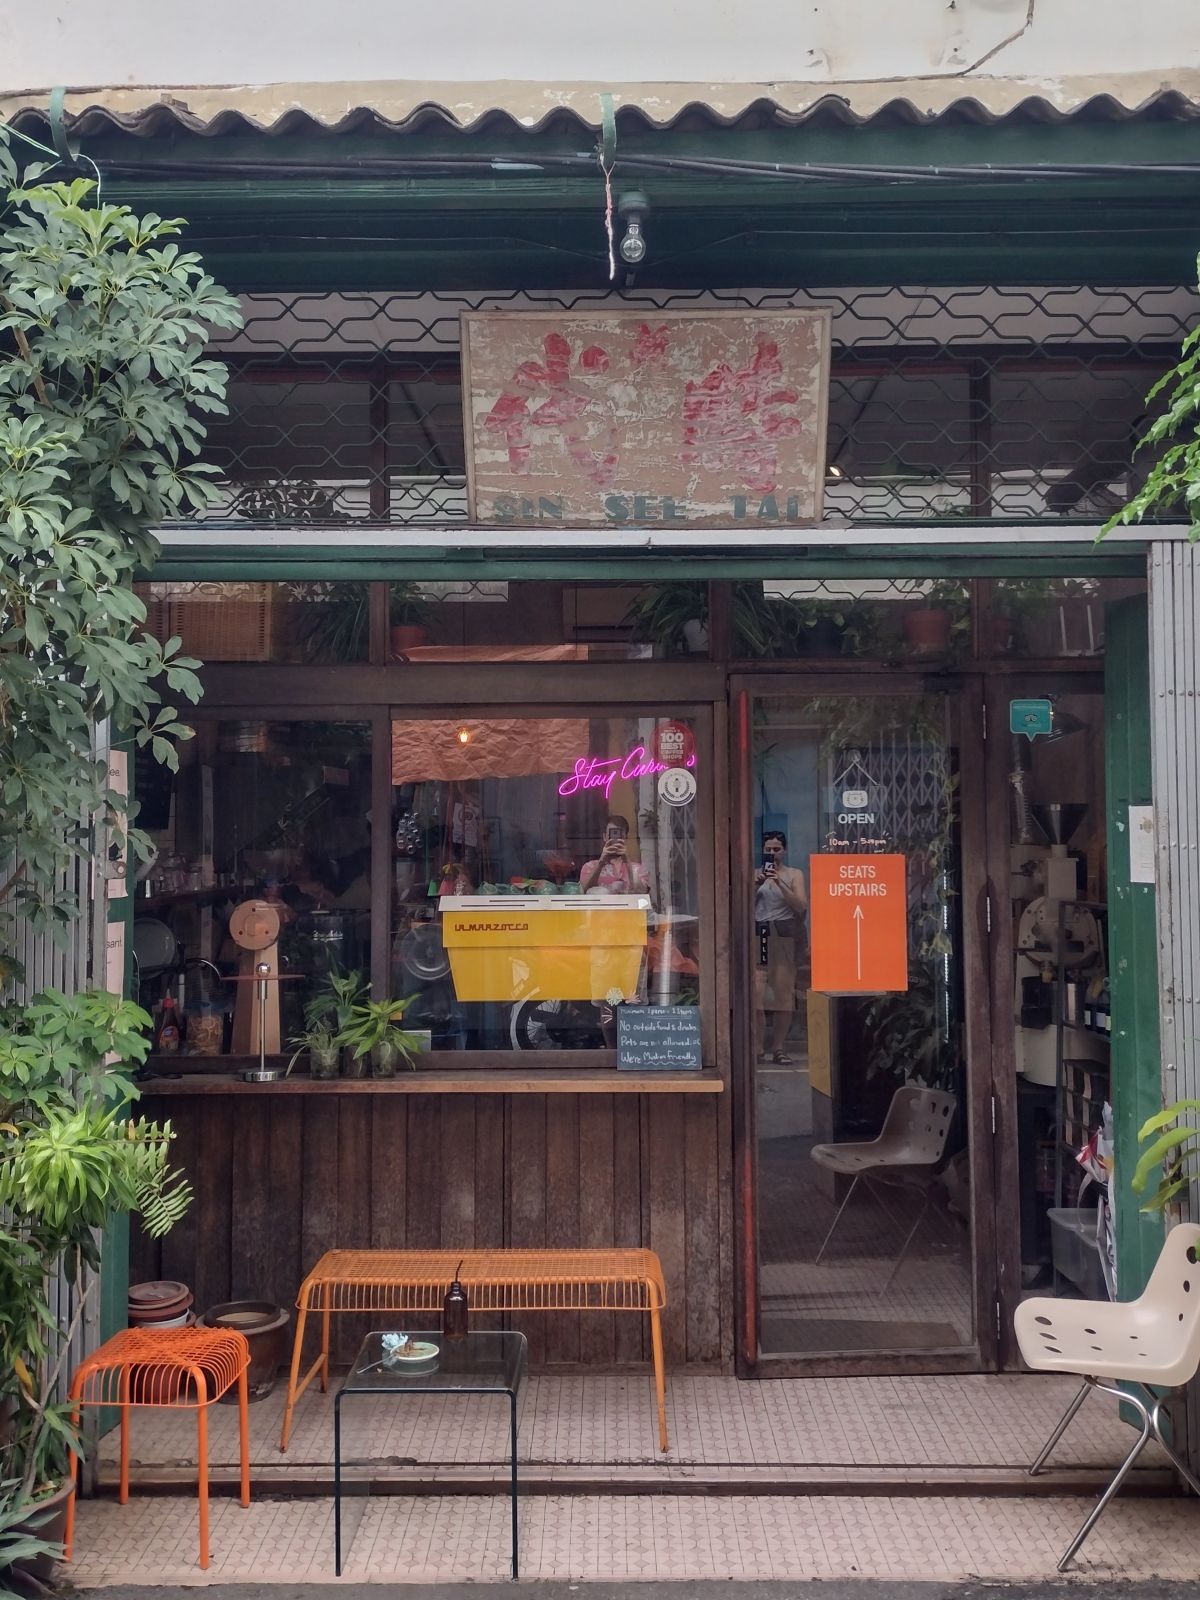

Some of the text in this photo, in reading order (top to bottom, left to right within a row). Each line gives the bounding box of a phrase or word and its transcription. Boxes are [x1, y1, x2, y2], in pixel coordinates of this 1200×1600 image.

[604, 495, 687, 520] SEE
[729, 495, 799, 521] TAI
[660, 732, 684, 743] 100
[558, 757, 622, 799] Stay
[837, 812, 875, 824] OPEN
[839, 865, 877, 879] SEATS
[829, 883, 887, 897] UPSTAIRS
[619, 1019, 631, 1032] No
[620, 1035, 638, 1047] Pets
[620, 1051, 641, 1064] We're
